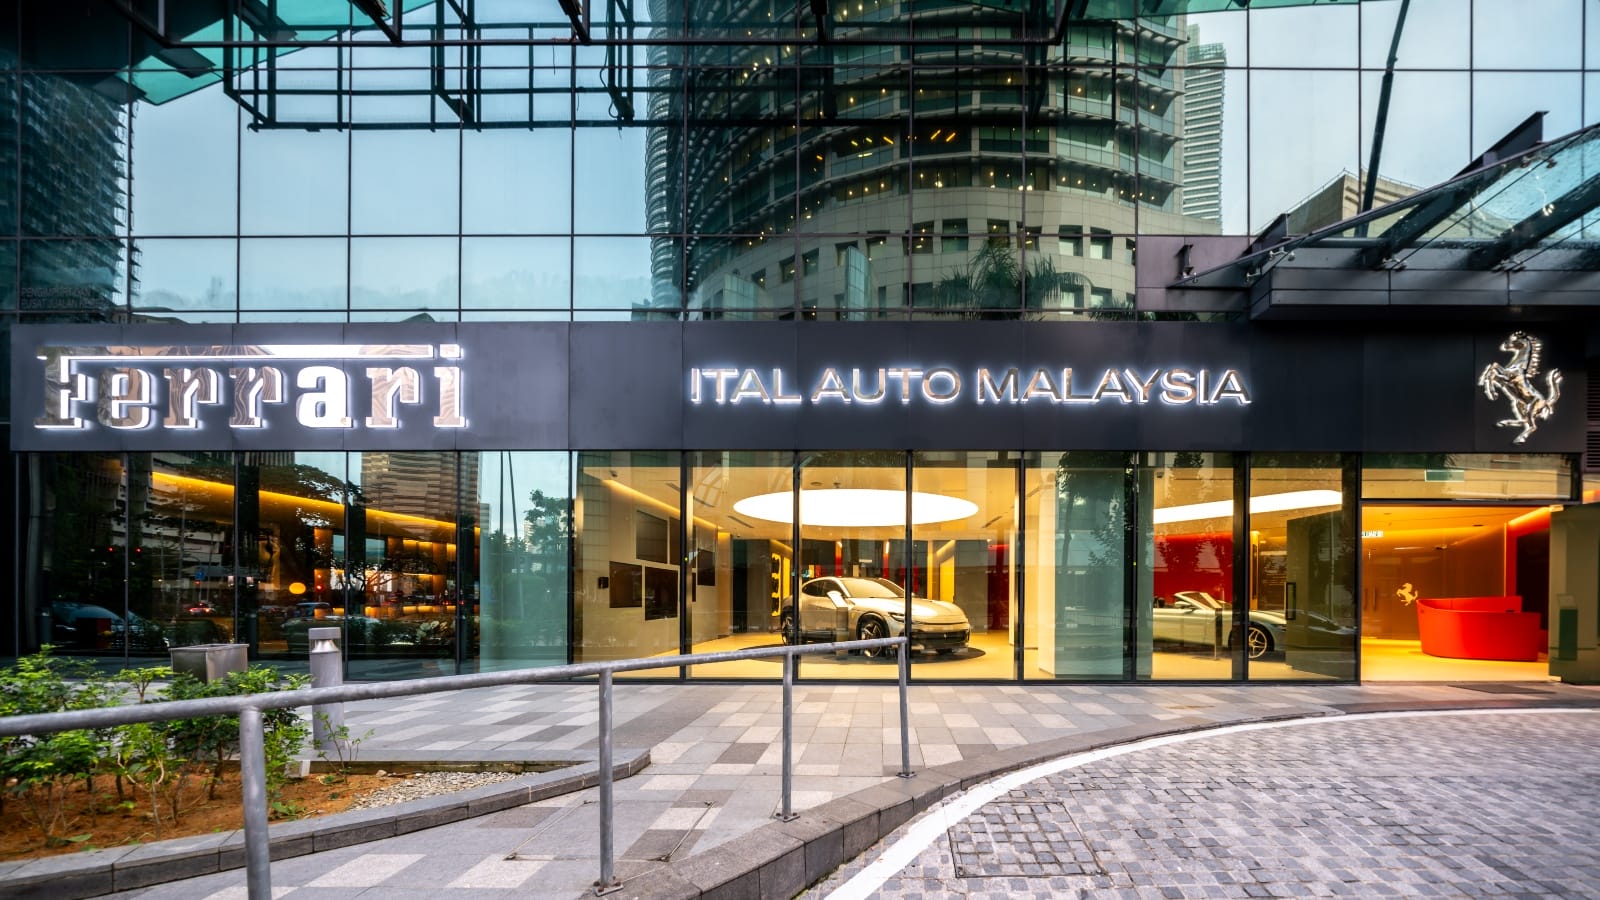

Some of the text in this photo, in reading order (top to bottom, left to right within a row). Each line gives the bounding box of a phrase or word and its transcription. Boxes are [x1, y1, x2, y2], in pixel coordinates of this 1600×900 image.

[34, 345, 467, 430] Ferrari
[690, 367, 1252, 405] ITAL AUTO MALAYSIA
